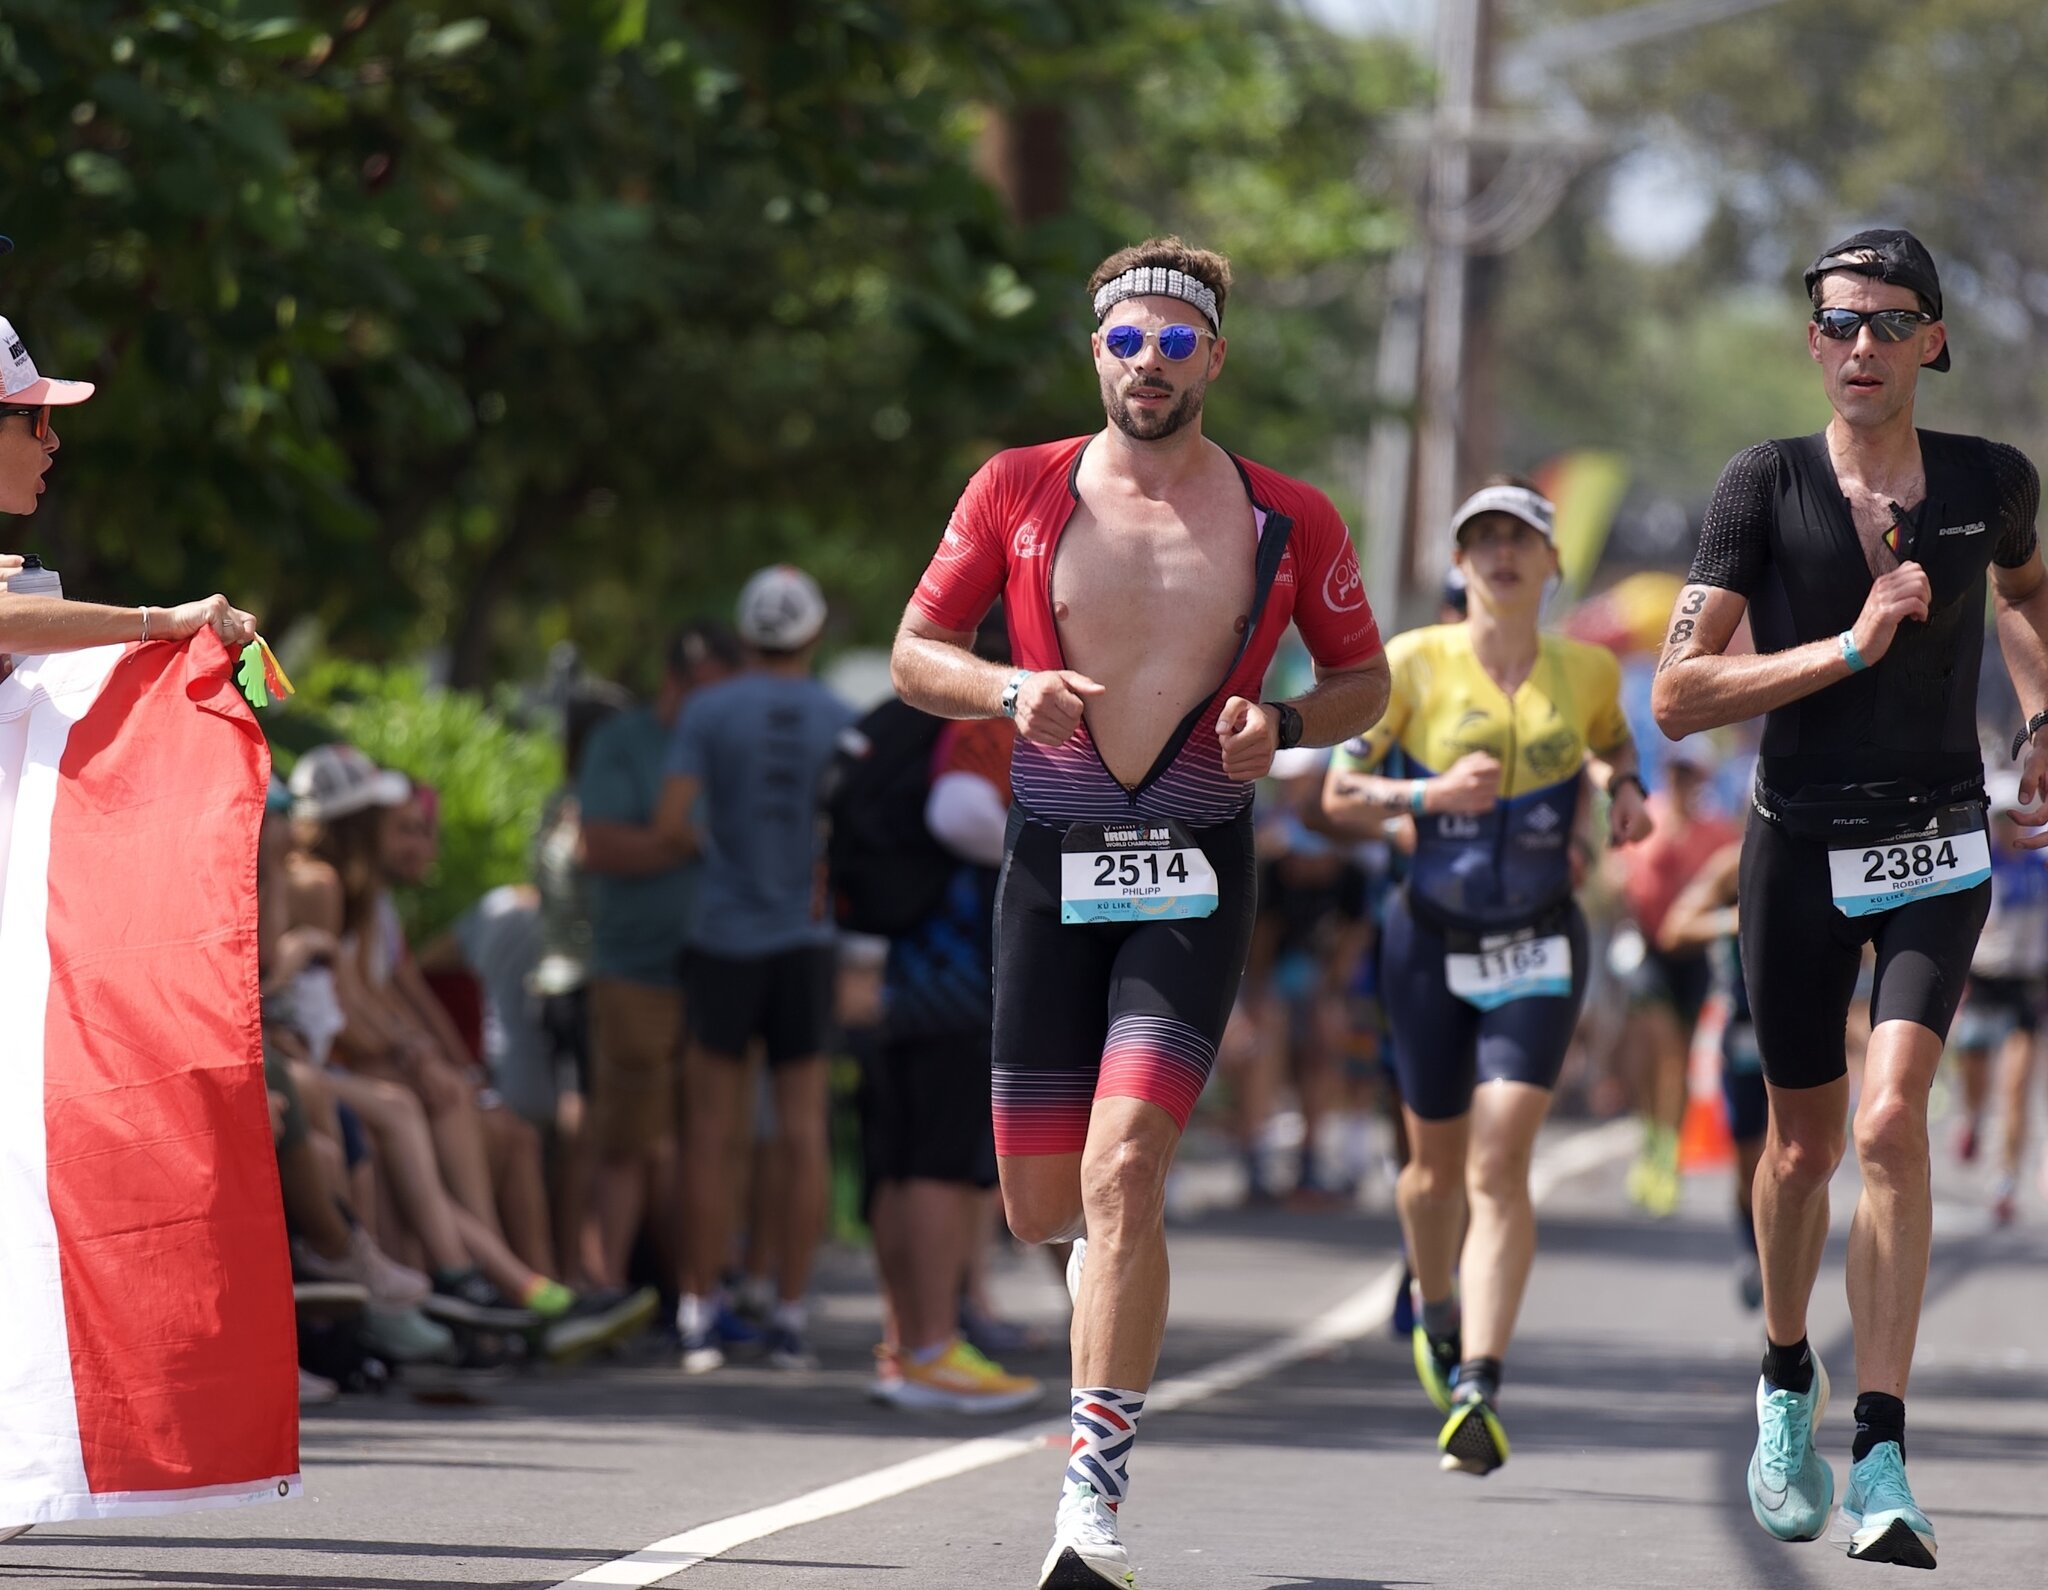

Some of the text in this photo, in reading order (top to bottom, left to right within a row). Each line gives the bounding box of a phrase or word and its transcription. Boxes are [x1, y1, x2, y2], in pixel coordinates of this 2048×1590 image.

[1832, 817, 1869, 825] FITLETIC
[1862, 840, 1959, 883] 2384
[1094, 852, 1189, 887] 2514
[1892, 876, 1935, 890] ROBERT
[1122, 887, 1161, 896] PHILIPP
[1886, 892, 1905, 902] LIKE
[1112, 902, 1132, 910] LIKE
